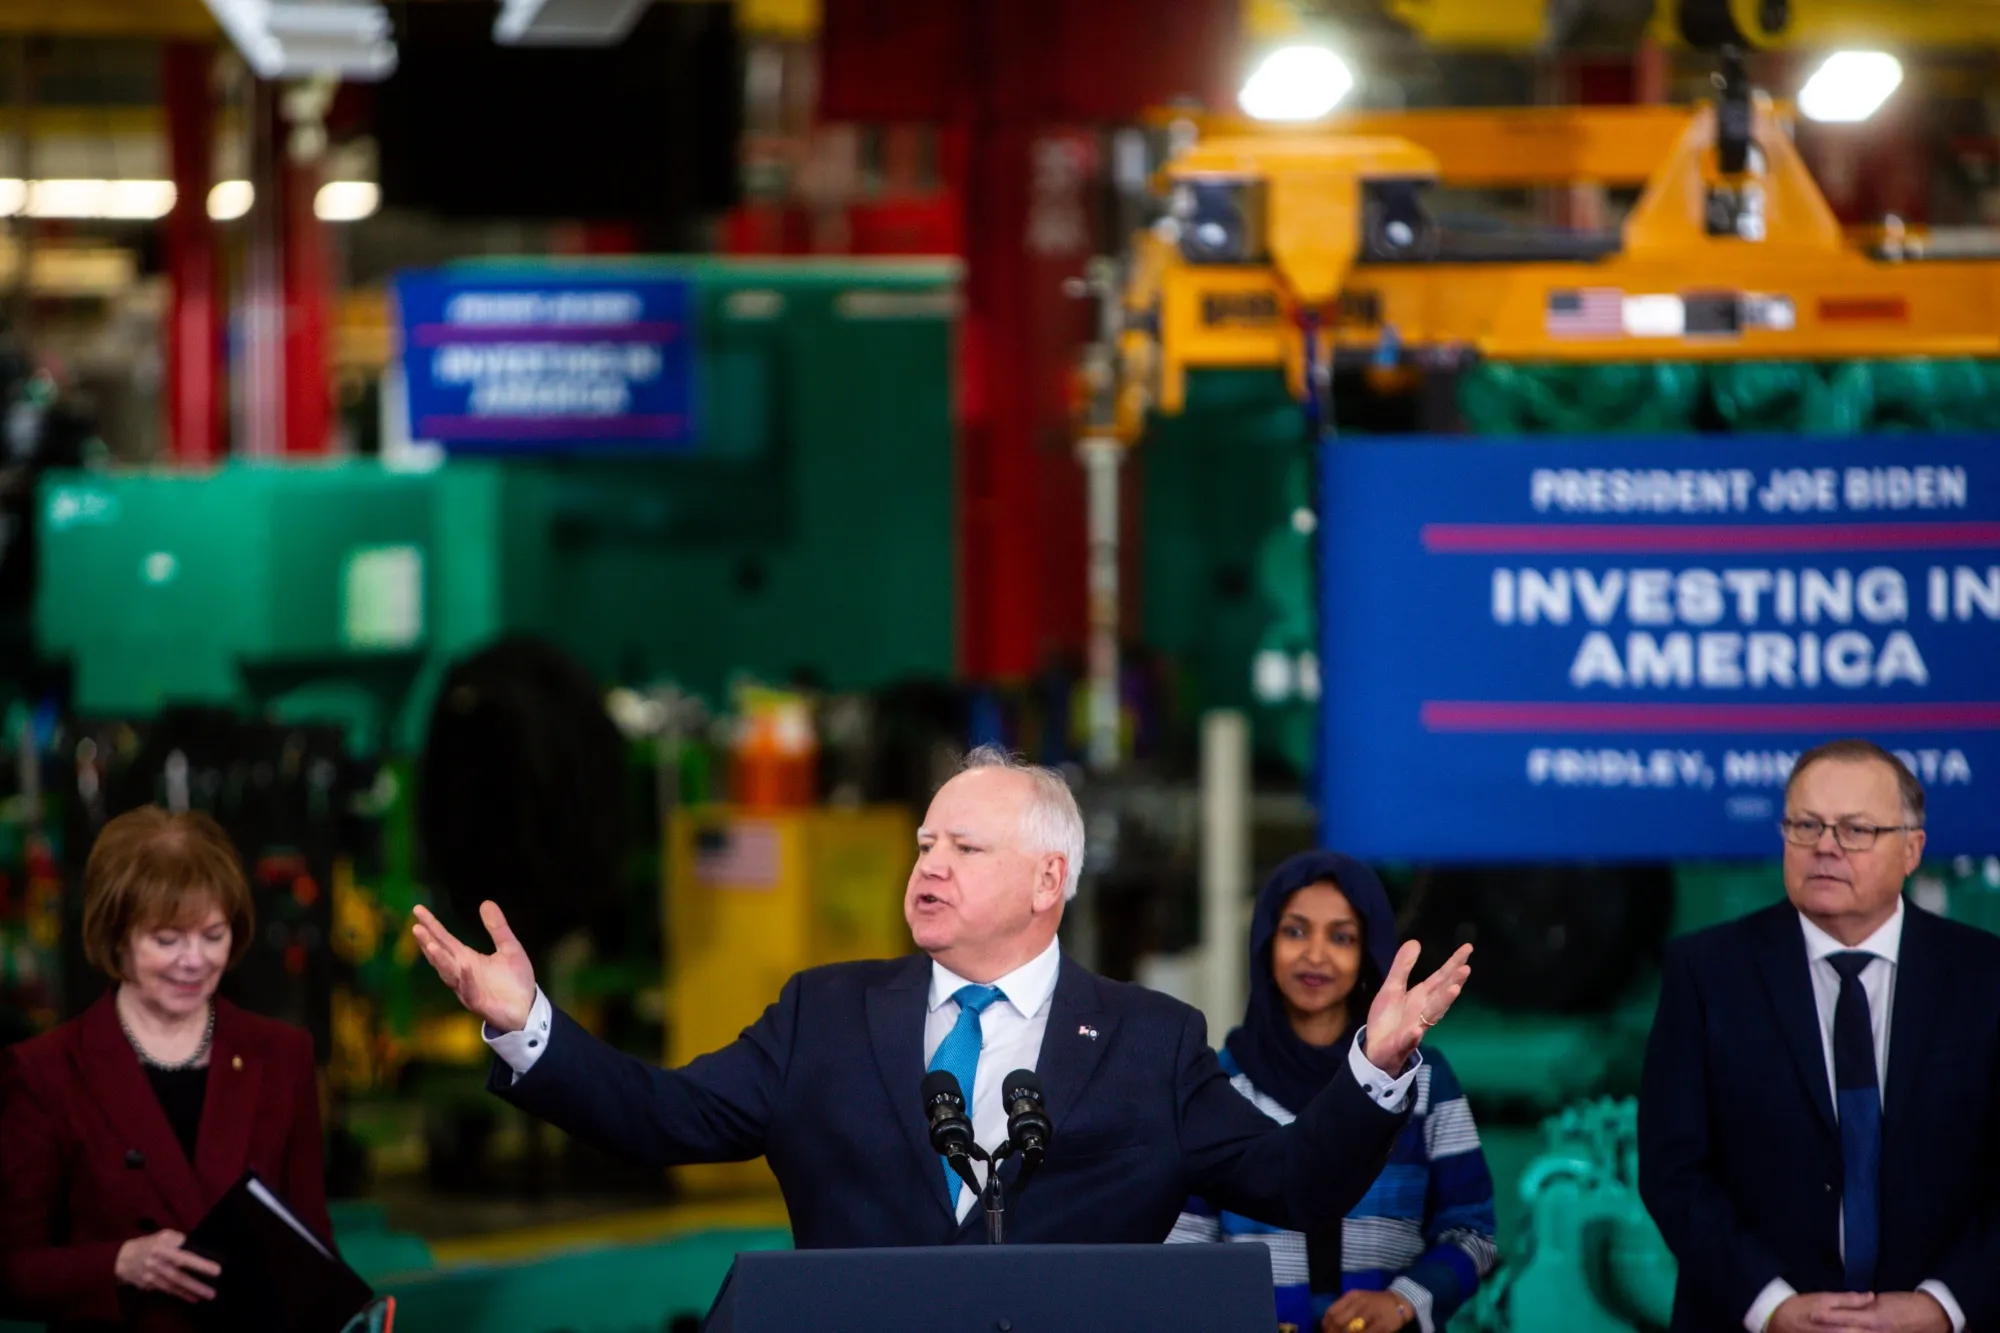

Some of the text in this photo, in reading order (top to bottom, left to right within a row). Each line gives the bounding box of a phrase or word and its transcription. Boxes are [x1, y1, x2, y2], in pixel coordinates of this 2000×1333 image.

[1532, 466, 1967, 511] PRESIDENT JOE BIDEN
[1492, 567, 2000, 624] INVESTING IN
[1571, 631, 1928, 688] AMERICA
[1527, 749, 1715, 788] FRIDLEY,
